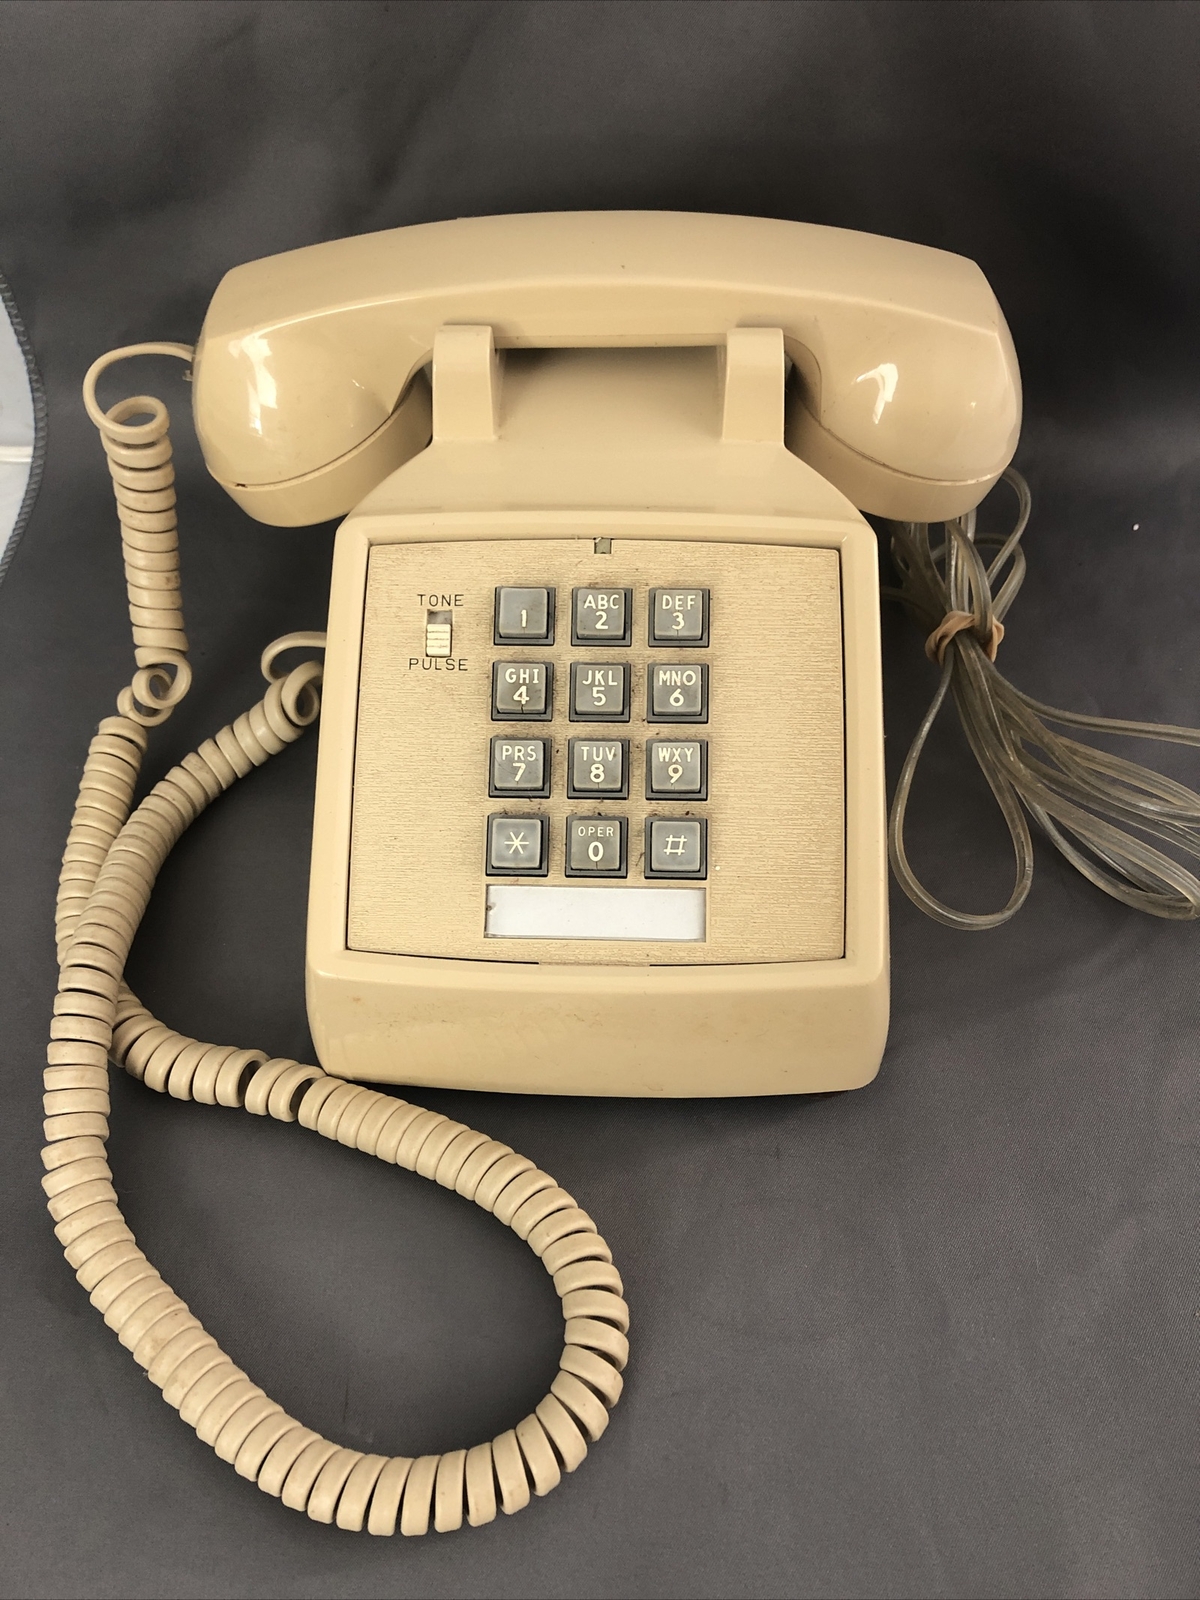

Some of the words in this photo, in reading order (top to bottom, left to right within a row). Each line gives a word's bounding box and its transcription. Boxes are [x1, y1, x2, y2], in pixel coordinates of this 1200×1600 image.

[417, 594, 464, 607] TONE
[583, 594, 620, 610] ABC
[661, 595, 696, 610] DEF
[519, 609, 528, 628] 1
[594, 611, 609, 630] 2
[671, 612, 685, 630] 3
[408, 658, 469, 671] PULSE
[505, 668, 540, 684] GHI
[582, 670, 618, 686] JKL
[658, 670, 697, 686] MNO
[513, 685, 530, 705] 4
[591, 686, 607, 706] 5
[669, 688, 685, 707] 6
[502, 745, 537, 761] PRS
[580, 746, 616, 762] TUV
[658, 747, 694, 763] WXY
[512, 762, 526, 782] 7
[589, 763, 605, 783] 8
[667, 764, 683, 784] 9
[577, 826, 614, 837] OPER
[588, 841, 604, 862] 0
